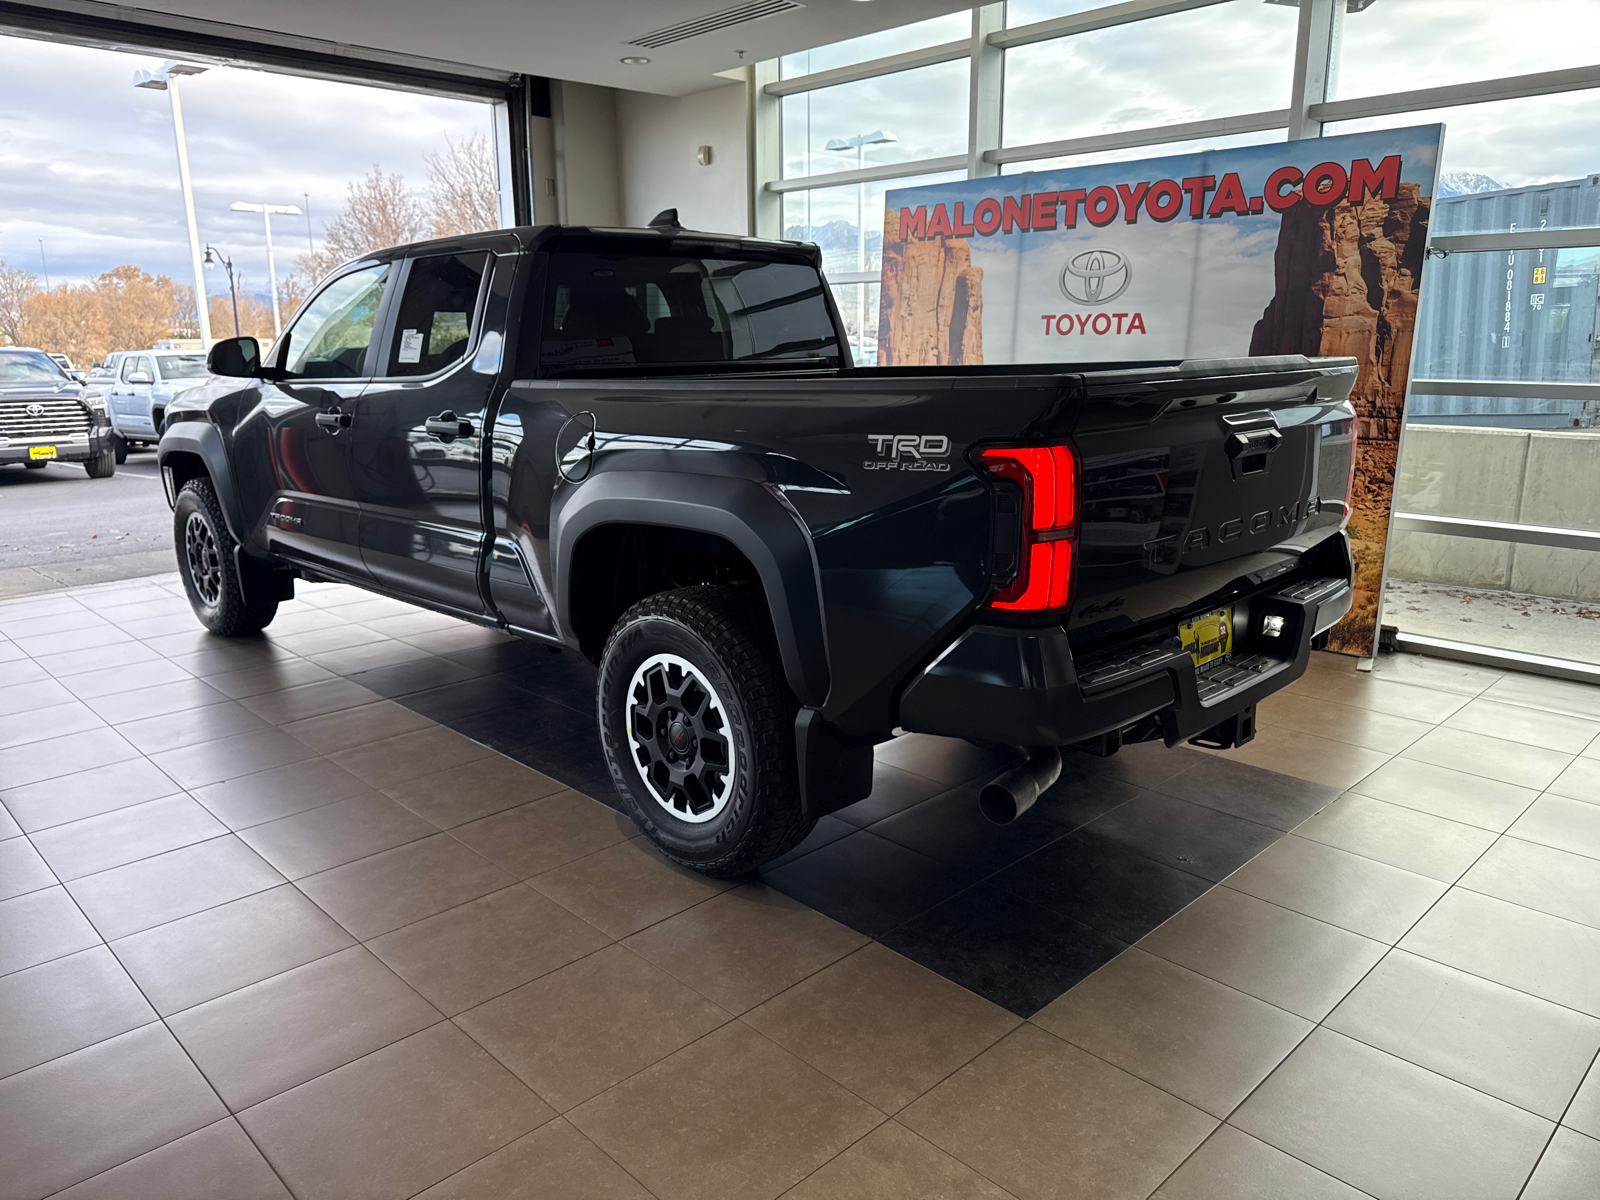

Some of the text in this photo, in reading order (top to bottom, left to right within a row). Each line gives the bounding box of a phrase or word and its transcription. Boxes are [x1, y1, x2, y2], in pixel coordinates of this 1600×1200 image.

[899, 155, 1403, 240] MALONETOYOTA.COM
[1042, 313, 1146, 336] TOYOTA
[867, 434, 952, 462] TRD
[863, 461, 951, 472] OFF ROAD
[1143, 496, 1321, 563] TACOMA
